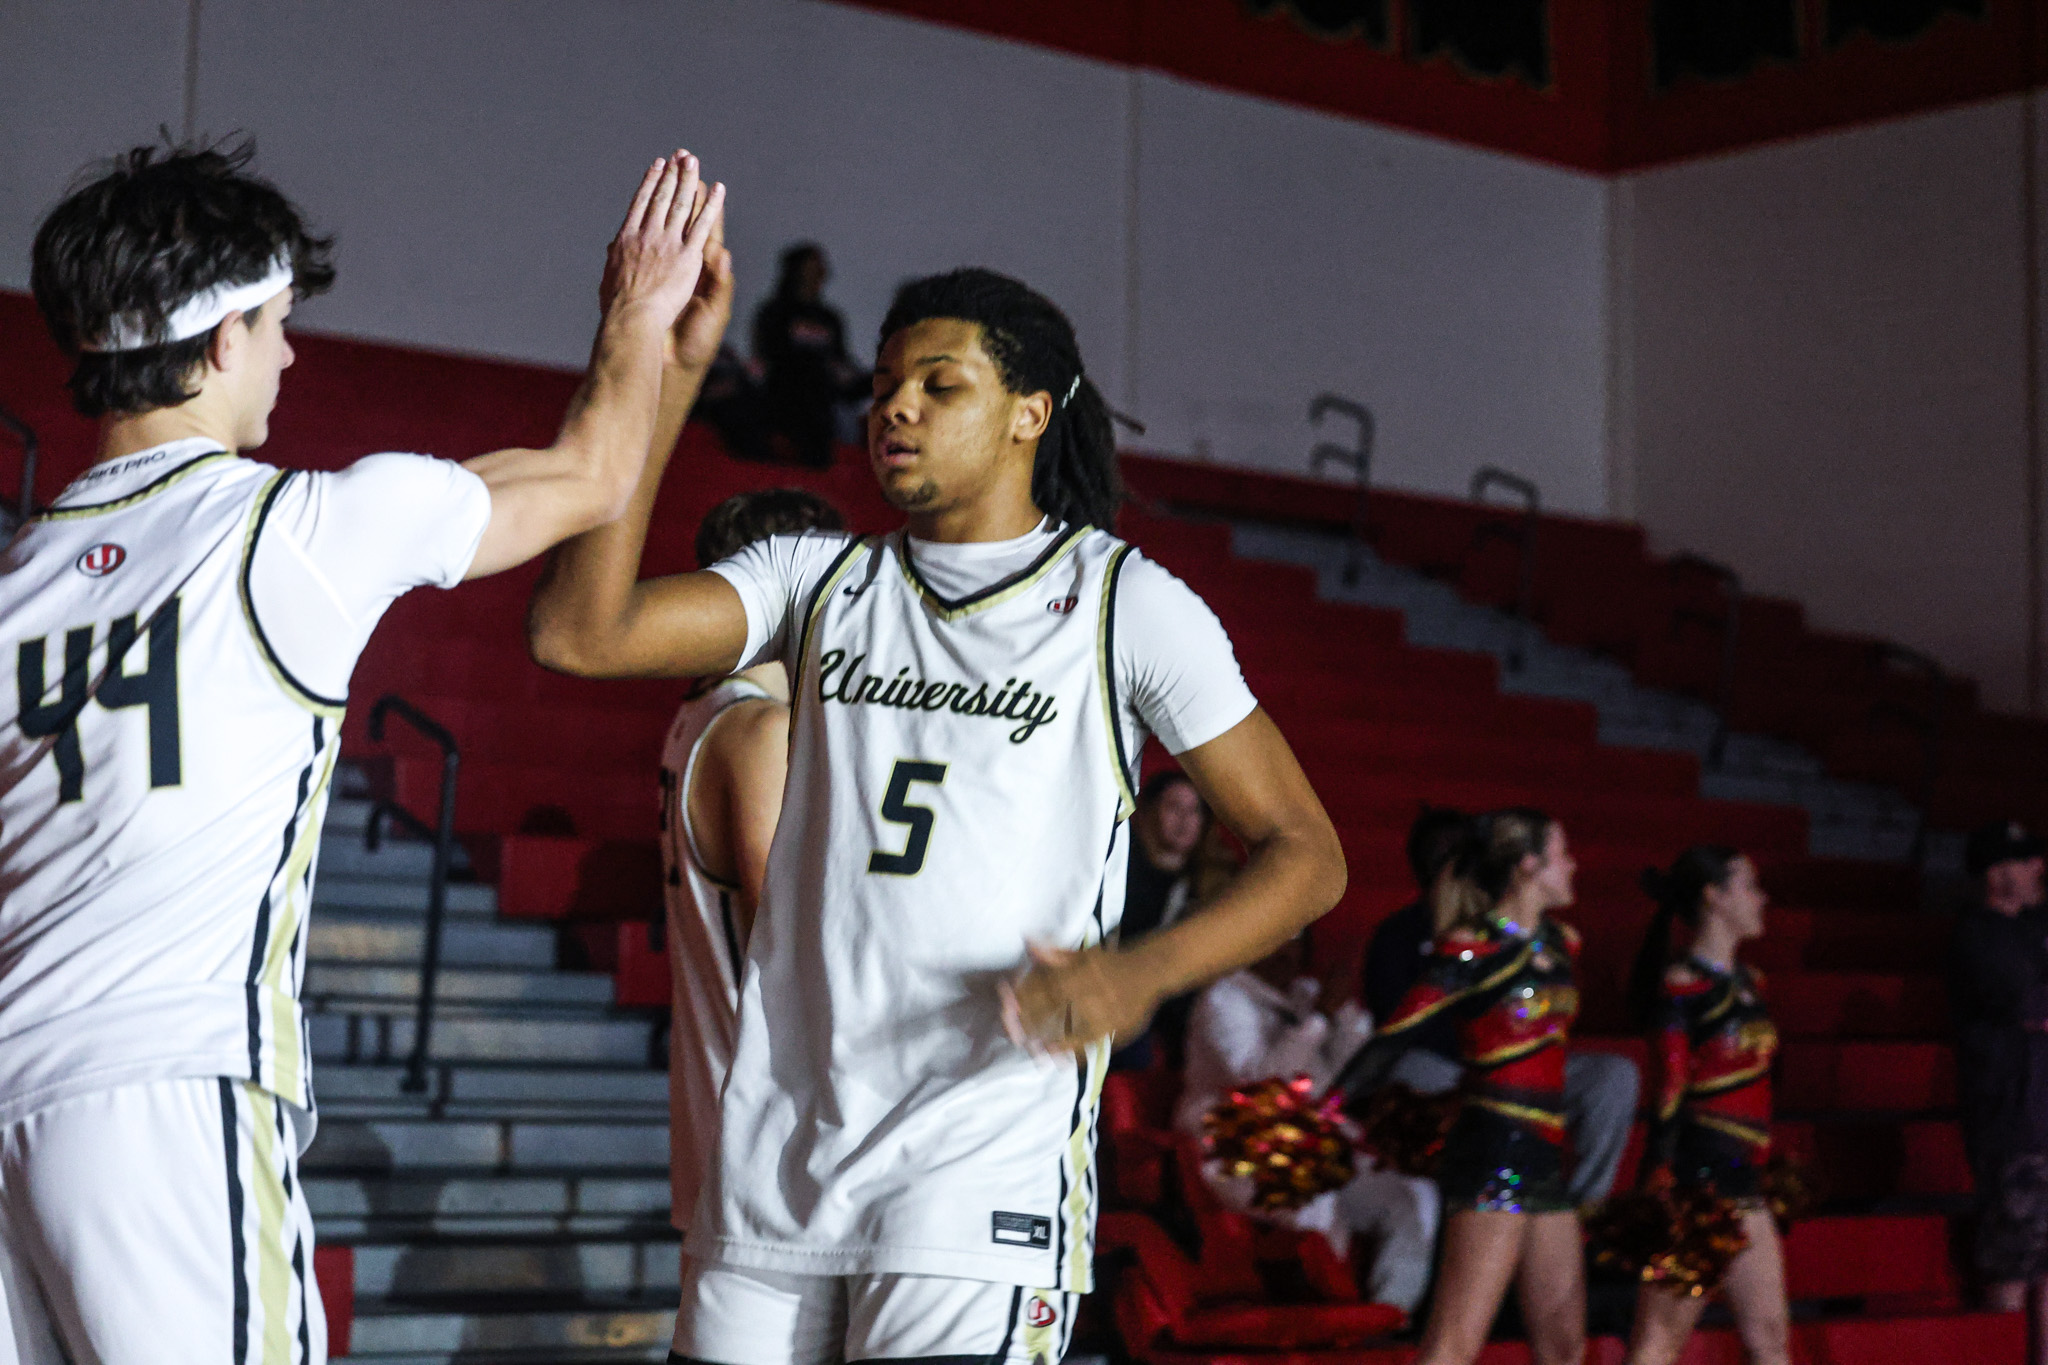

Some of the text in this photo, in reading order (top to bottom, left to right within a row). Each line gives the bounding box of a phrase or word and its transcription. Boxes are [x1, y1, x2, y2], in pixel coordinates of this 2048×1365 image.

[123, 450, 166, 473] PRO
[18, 596, 182, 804] 44
[818, 649, 1058, 744] University
[867, 758, 950, 877] 5
